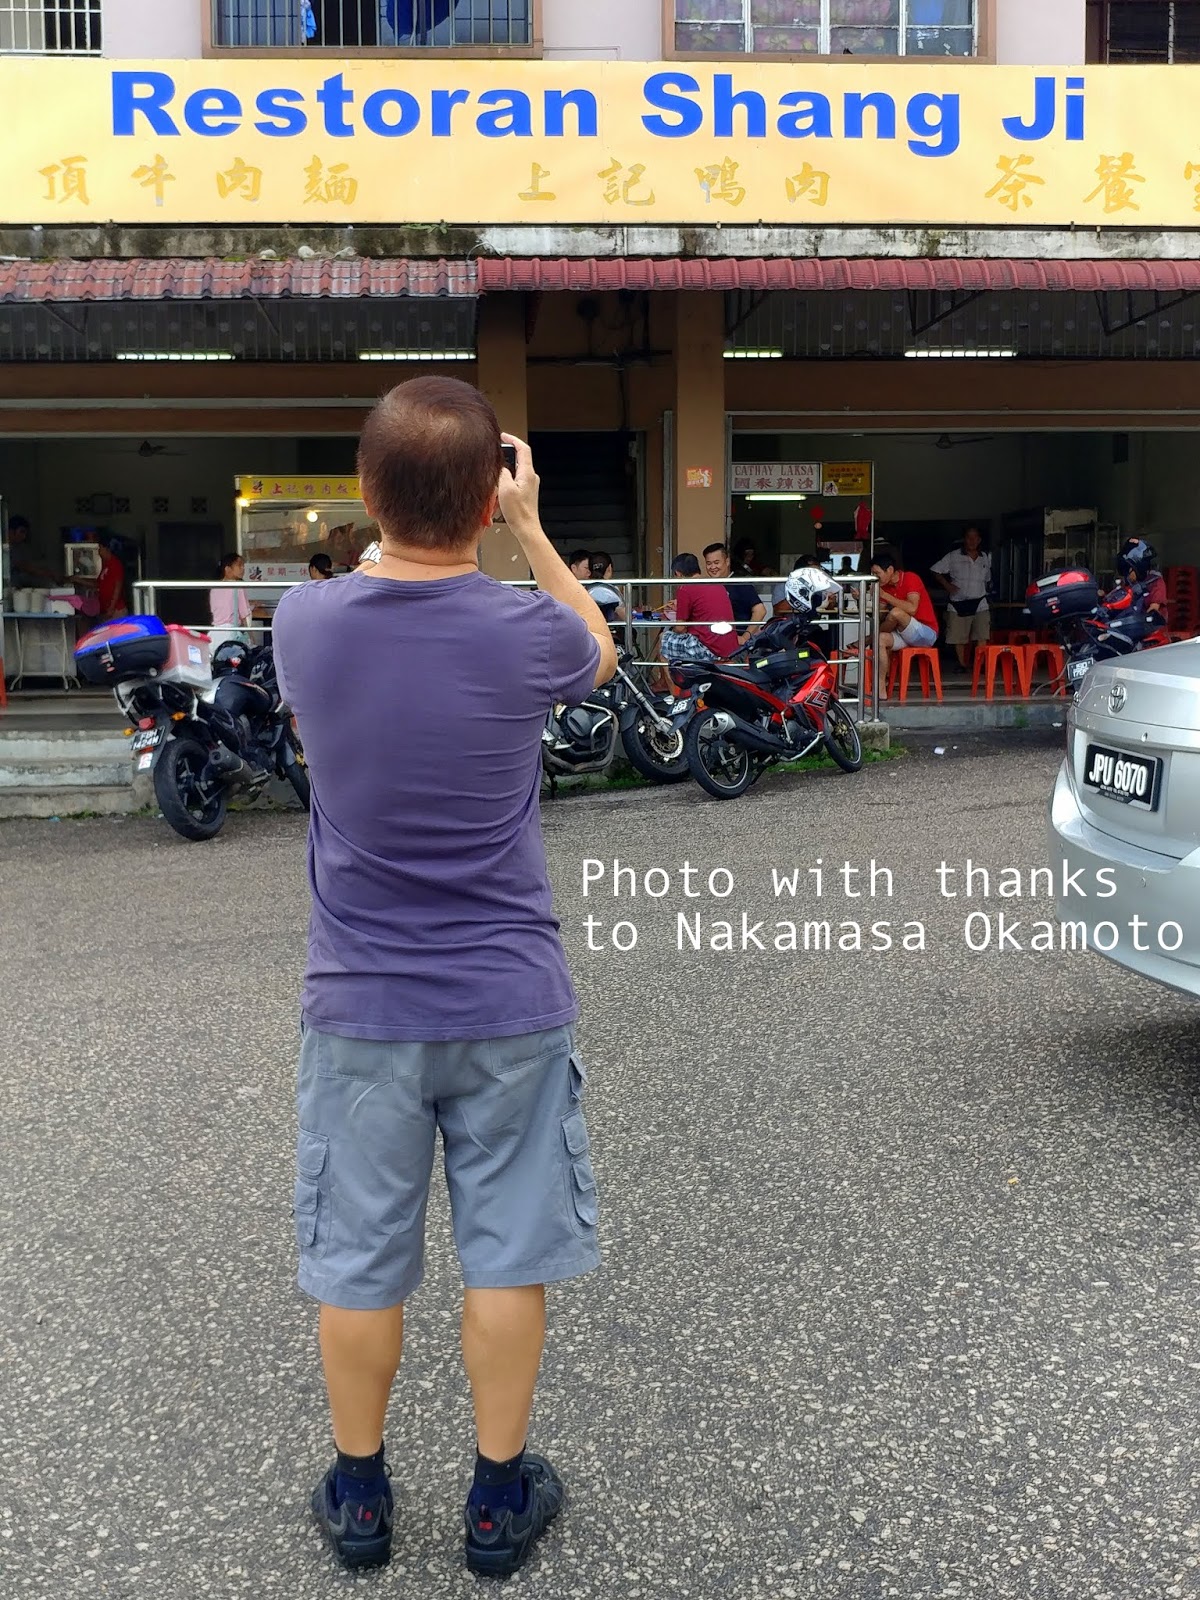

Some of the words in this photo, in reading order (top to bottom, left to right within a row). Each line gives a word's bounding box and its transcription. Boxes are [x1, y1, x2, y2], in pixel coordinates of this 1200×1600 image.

[112, 71, 597, 137] Restoran
[641, 72, 960, 157] Shang
[1002, 77, 1085, 141] Ji
[734, 465, 774, 476] CATHAY
[780, 465, 814, 476] LAKSA
[1088, 753, 1115, 786] JPU
[1113, 759, 1149, 797] 6070
